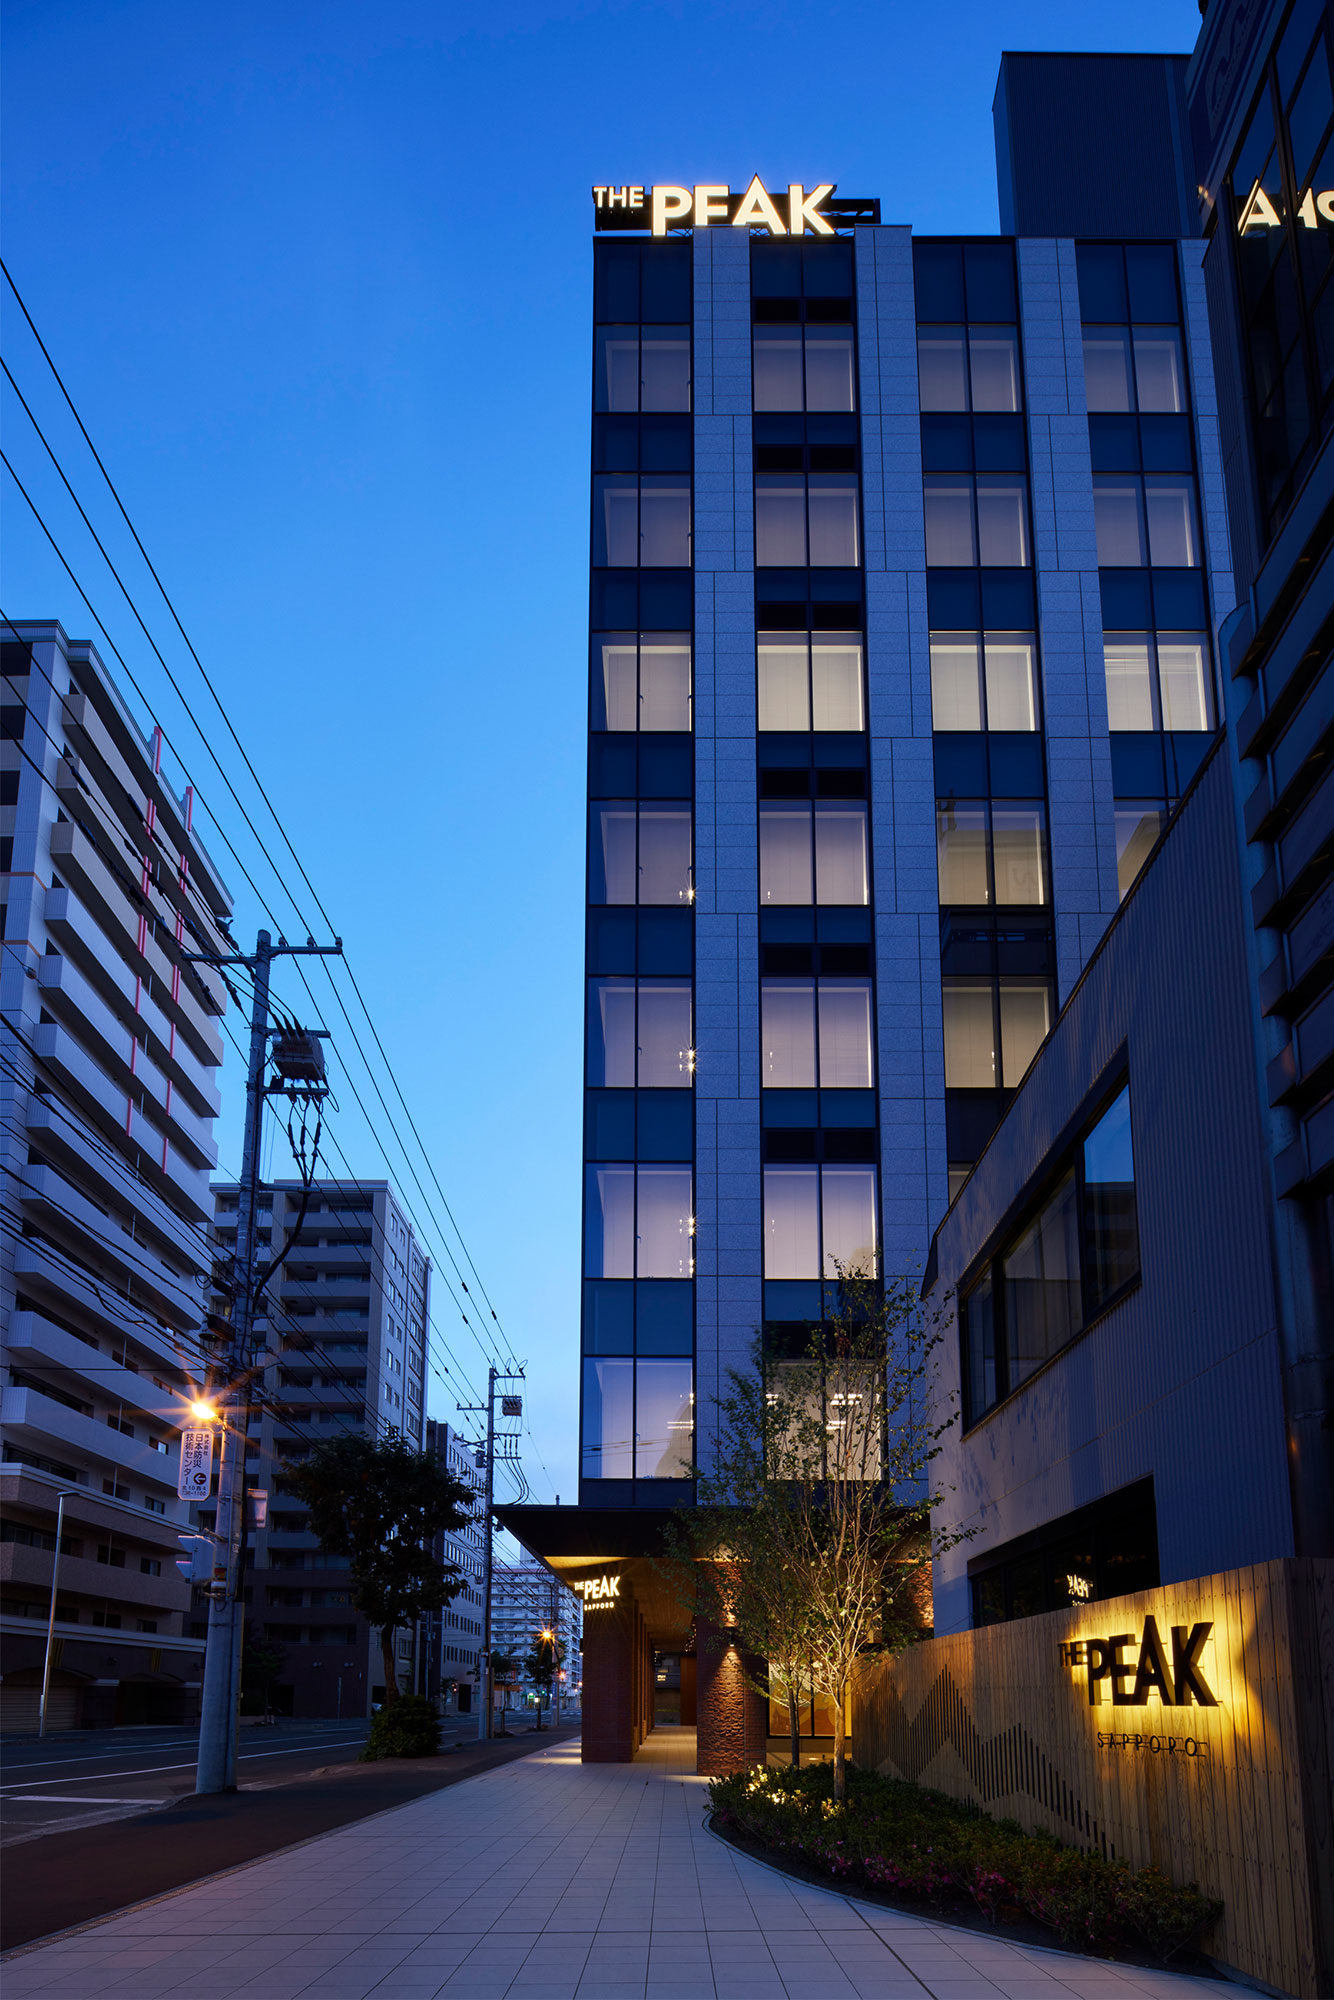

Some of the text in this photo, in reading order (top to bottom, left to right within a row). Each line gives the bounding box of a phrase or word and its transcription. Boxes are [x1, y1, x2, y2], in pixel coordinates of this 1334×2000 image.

[592, 172, 837, 236] THE PEAK
[184, 1434, 194, 1485] 技術センター
[193, 1434, 203, 1468] 日本防災
[574, 1575, 620, 1600] THE PEAK
[584, 1602, 615, 1611] SAPPORO
[1057, 1615, 1219, 1707] THE PEAK
[1097, 1731, 1198, 1757] SAPPORO
